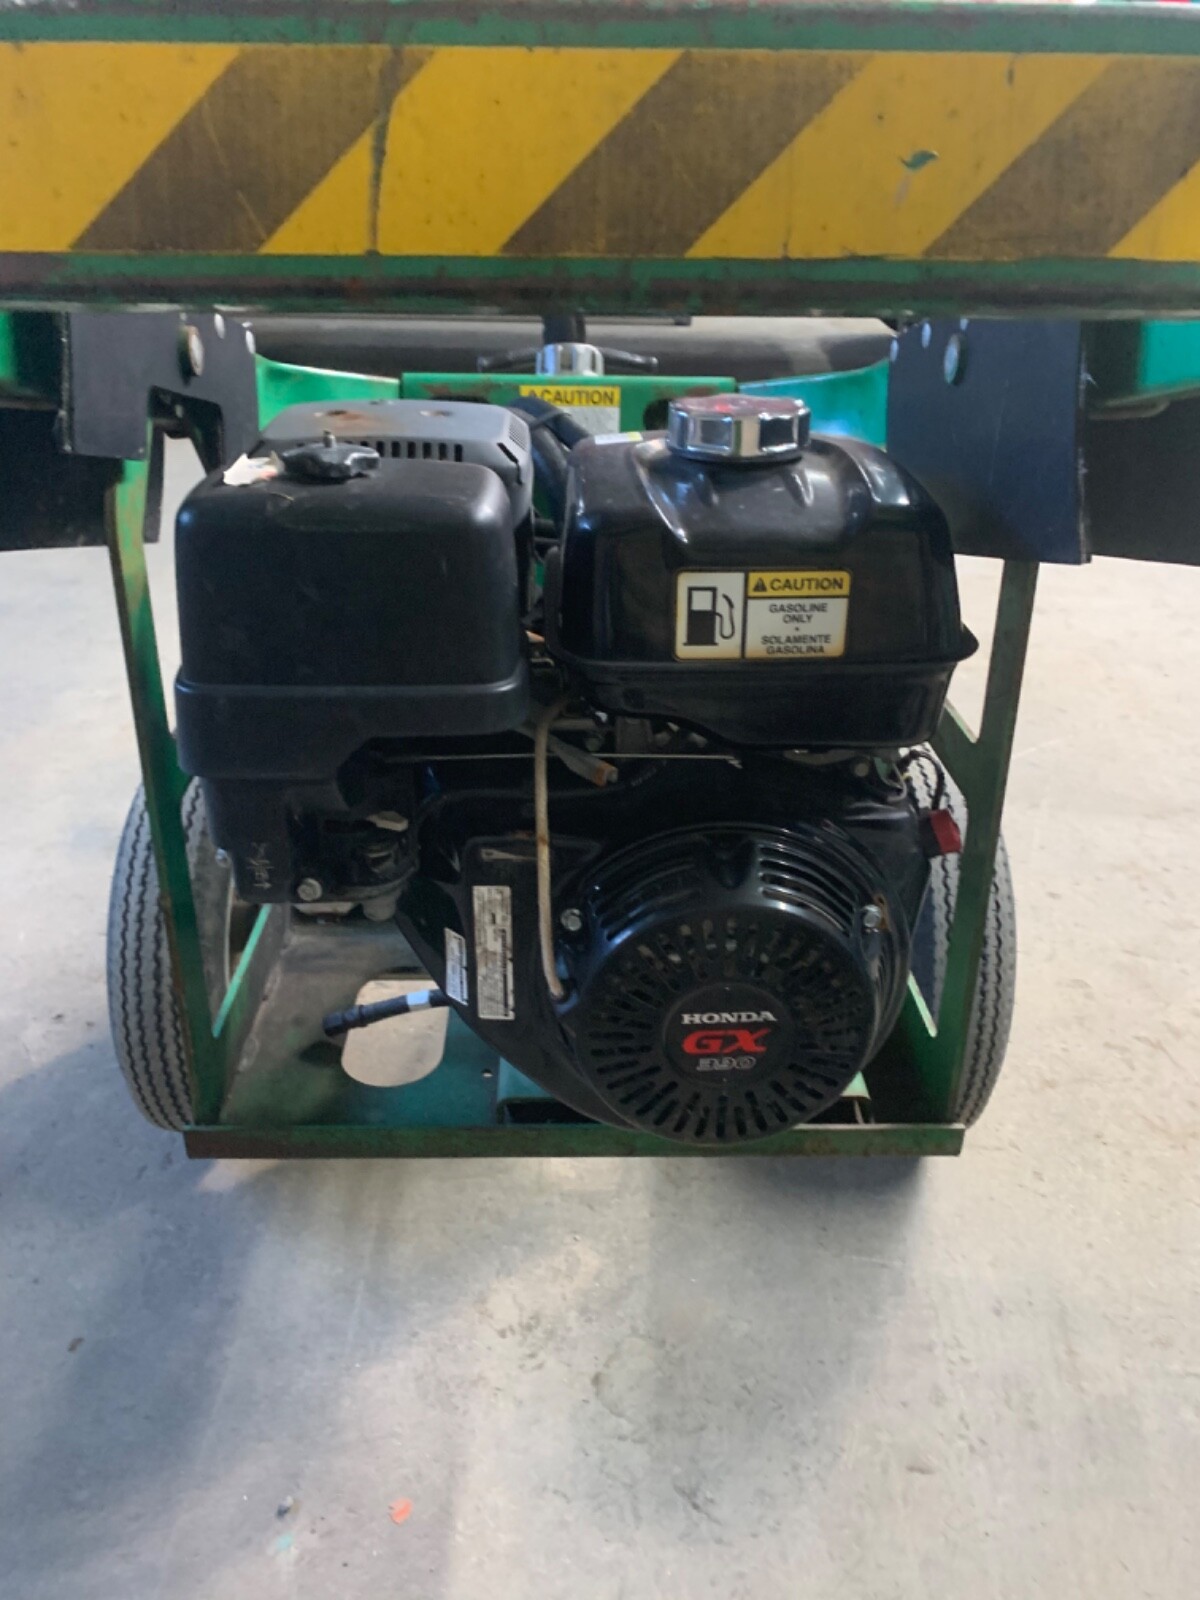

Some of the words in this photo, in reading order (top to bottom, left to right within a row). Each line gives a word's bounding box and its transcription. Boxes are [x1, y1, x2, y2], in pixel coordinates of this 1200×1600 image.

[541, 389, 614, 404] CAUTION
[770, 577, 844, 591] CAUTION
[769, 603, 828, 613] GASOLINE
[782, 614, 813, 624] ONLY
[761, 634, 832, 645] SOLAMENTE
[766, 645, 825, 655] GASOLINA
[681, 1011, 778, 1024] HONDA
[682, 1028, 771, 1054] GX
